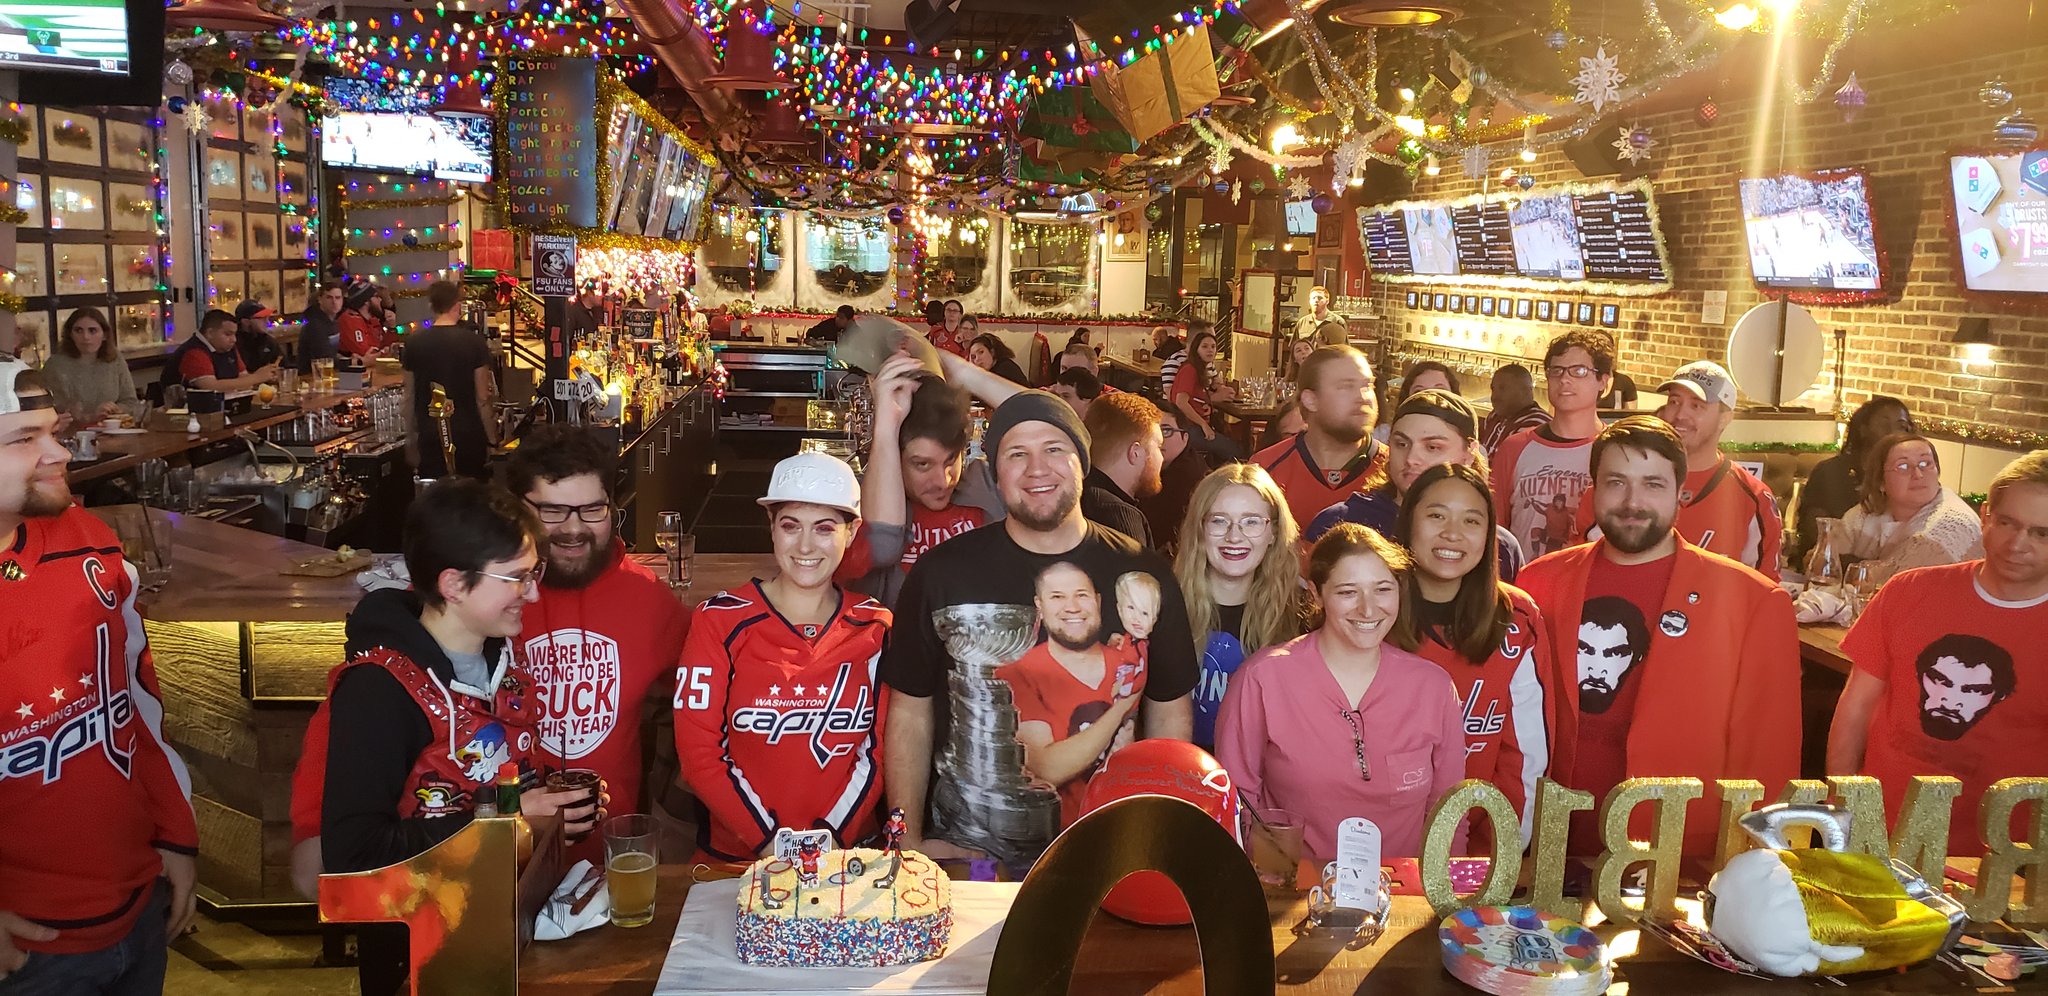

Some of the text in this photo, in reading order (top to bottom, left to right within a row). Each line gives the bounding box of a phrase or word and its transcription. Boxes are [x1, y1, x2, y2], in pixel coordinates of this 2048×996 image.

[540, 107, 566, 118] Cty
[534, 235, 573, 243] RESERVED
[537, 242, 570, 250] PARKING
[536, 277, 573, 286] FSU FANS
[581, 381, 592, 398] 20
[1520, 477, 1592, 498] KUZNET
[82, 556, 118, 610] C
[1500, 622, 1521, 659] C
[582, 641, 610, 663] NOT
[532, 661, 614, 685] GOING TO BE
[673, 666, 712, 710] 25
[536, 678, 617, 721] SUCK
[754, 697, 827, 708] WASHINGTON
[1, 691, 97, 744] WASHINGTON
[571, 715, 612, 737] YEAR
